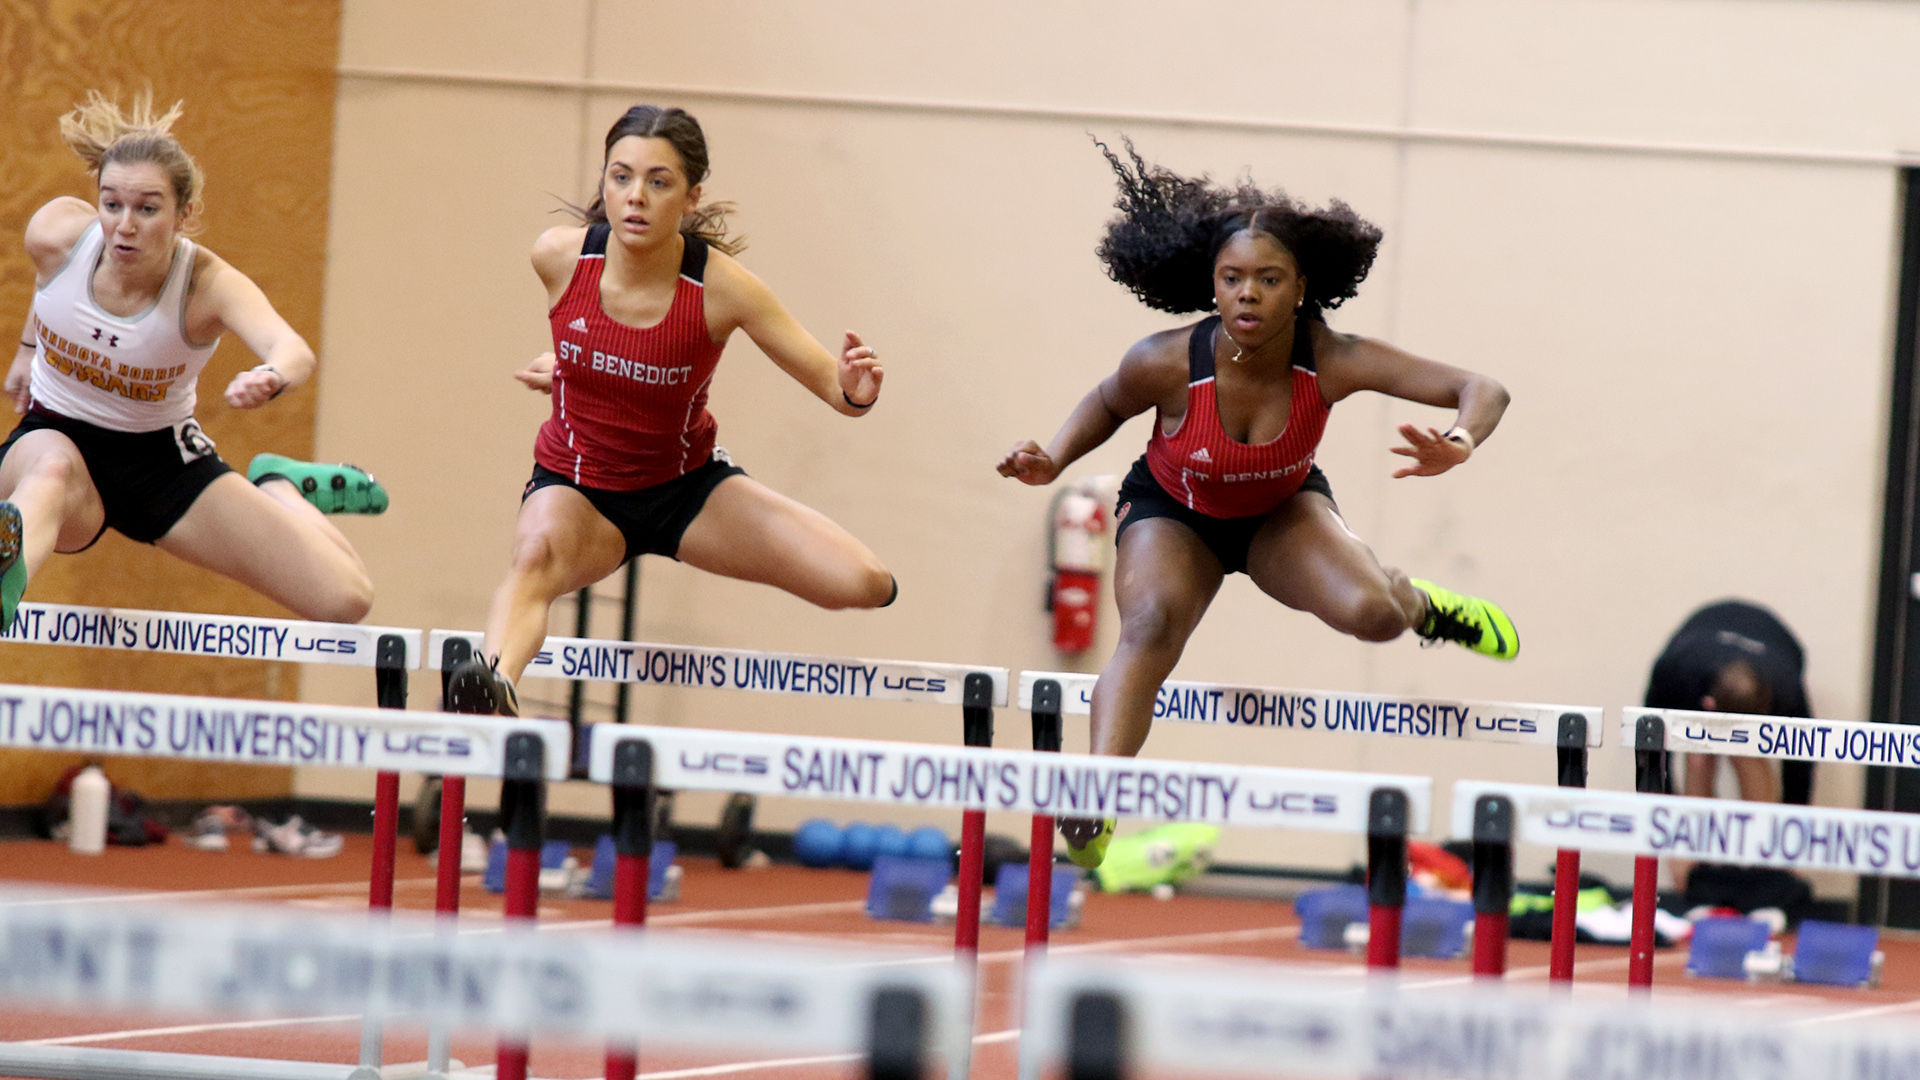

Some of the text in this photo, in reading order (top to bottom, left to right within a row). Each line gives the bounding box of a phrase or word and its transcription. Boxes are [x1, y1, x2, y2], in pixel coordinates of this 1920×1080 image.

[118, 362, 187, 382] MORRIS
[560, 340, 692, 386] ST. BENEDICT
[48, 611, 139, 648] JOHN'S
[145, 619, 289, 657] UNIVERSITY
[294, 637, 357, 654] UCS
[562, 646, 947, 697] SAINT JOHN'S UNIVERSITY UCS
[28, 699, 156, 750] JOHN'S
[168, 707, 371, 765] UNIVERSITY
[1153, 686, 1537, 738] SAINT JOHN'S UNIVERSITY UCS
[1758, 722, 1832, 759] SAINT
[782, 747, 885, 798] SAINT
[891, 756, 1020, 808] JOHN'S
[1030, 766, 1239, 821] UNIVERSITY
[1648, 806, 1754, 858] SAINT
[1759, 817, 1891, 869] JOHN'S
